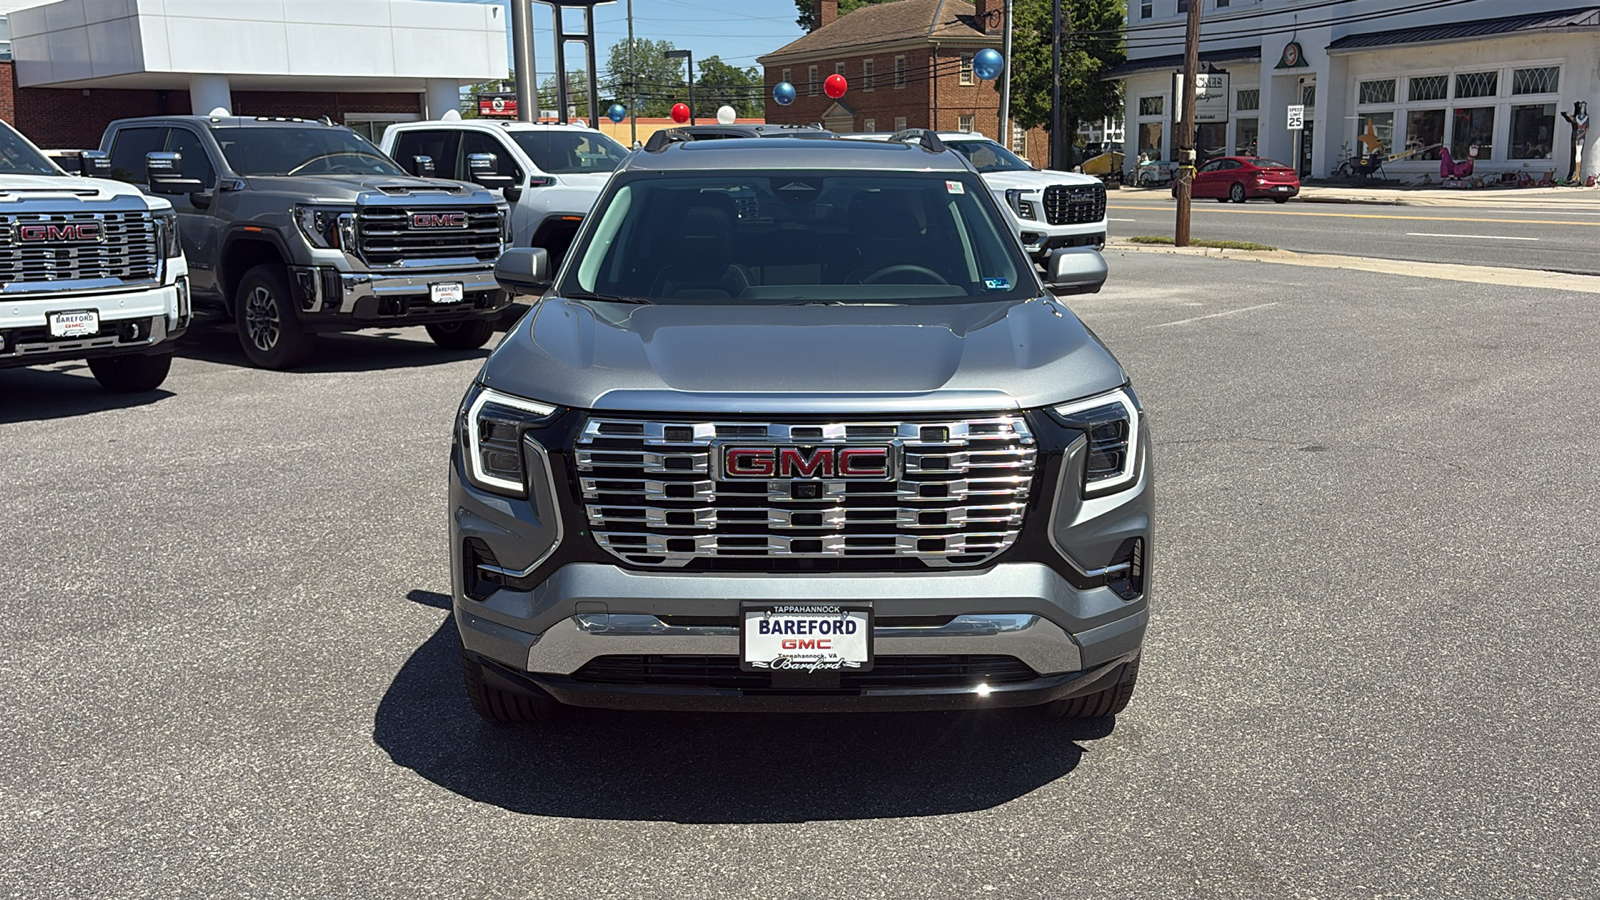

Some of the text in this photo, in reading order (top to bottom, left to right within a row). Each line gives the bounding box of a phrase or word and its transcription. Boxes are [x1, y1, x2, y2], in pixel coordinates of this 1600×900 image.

[1289, 117, 1302, 127] 25
[414, 214, 465, 226] GMC
[22, 224, 100, 241] GMC
[55, 315, 94, 323] BAREFORD
[725, 447, 888, 477] GMC
[773, 605, 840, 613] TAPPAHANNOCK
[759, 620, 857, 635] BAREFORD
[781, 639, 833, 650] GMC
[770, 656, 846, 674] Bareford
